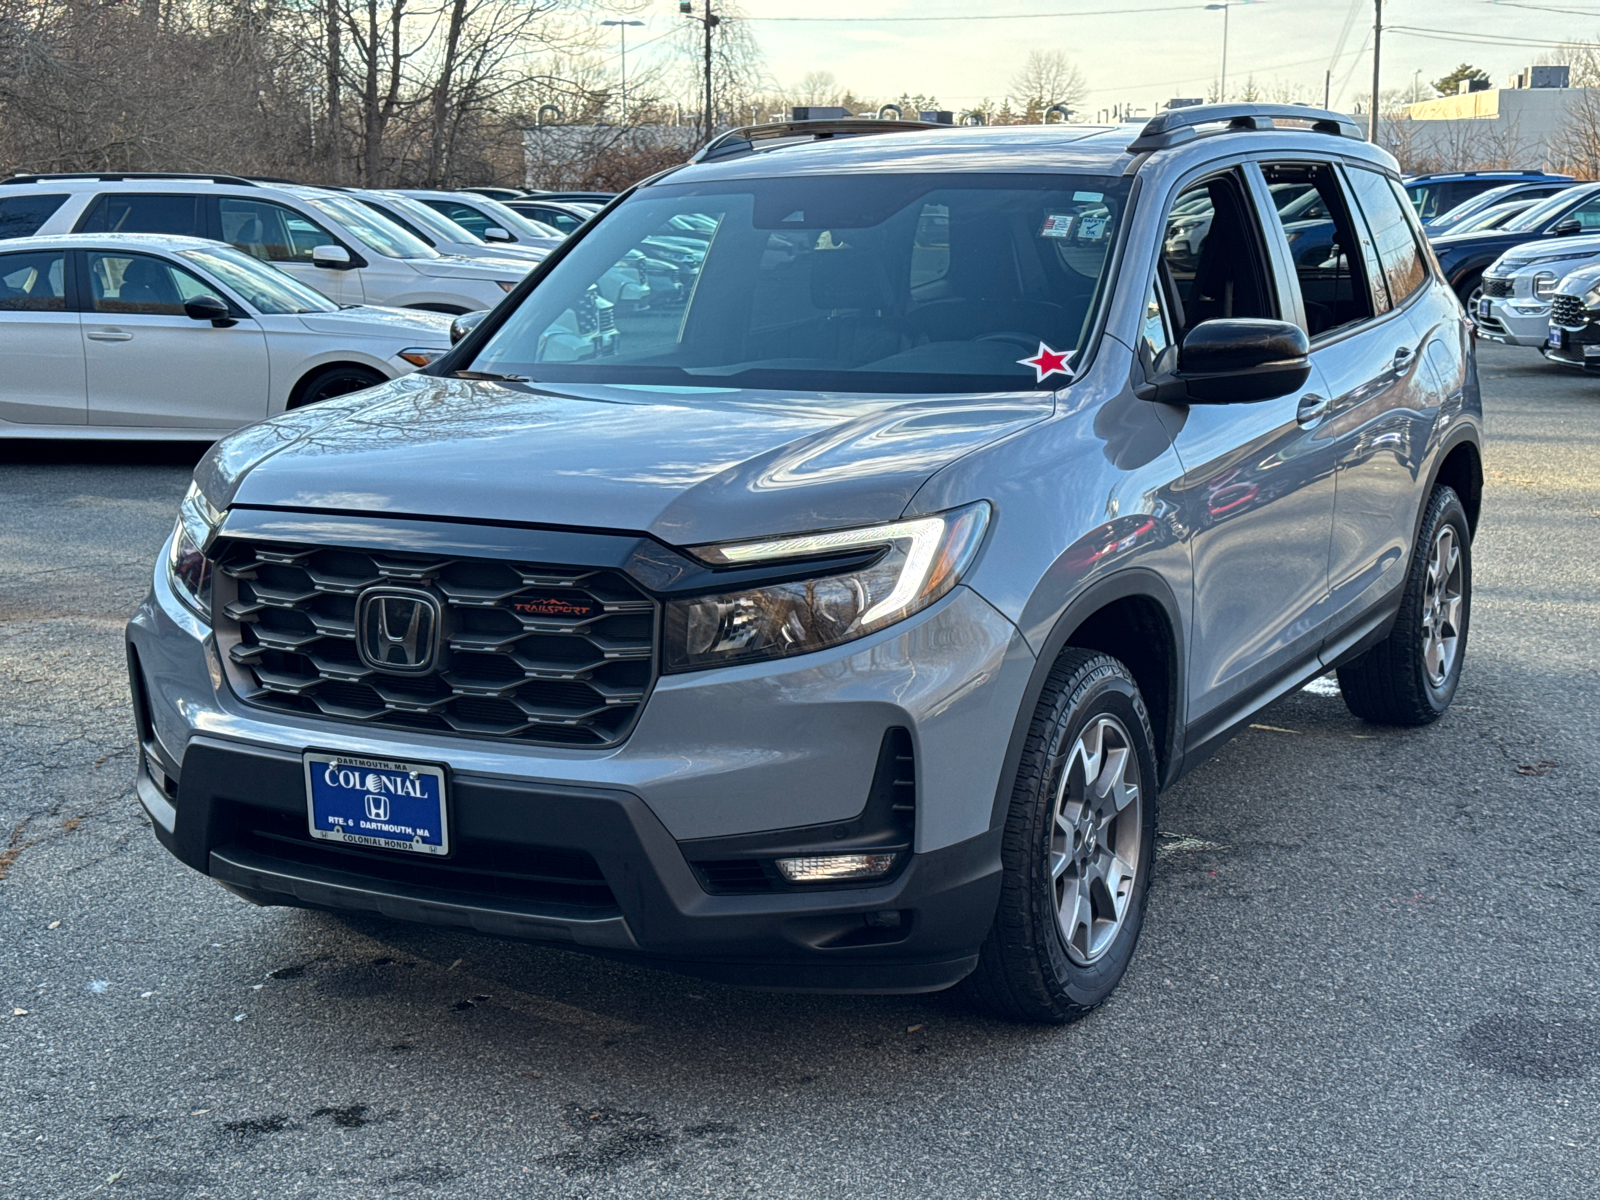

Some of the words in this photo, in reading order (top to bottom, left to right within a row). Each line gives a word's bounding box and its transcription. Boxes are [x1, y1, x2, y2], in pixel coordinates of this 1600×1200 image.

[514, 603, 590, 615] TRAILSPORT
[324, 767, 428, 798] COLONIAL
[328, 816, 347, 825] RTE.
[360, 820, 415, 836] DARTMOUTH,
[416, 828, 430, 837] MA
[343, 834, 382, 846] COLONIAL
[384, 840, 414, 850] HONDA
